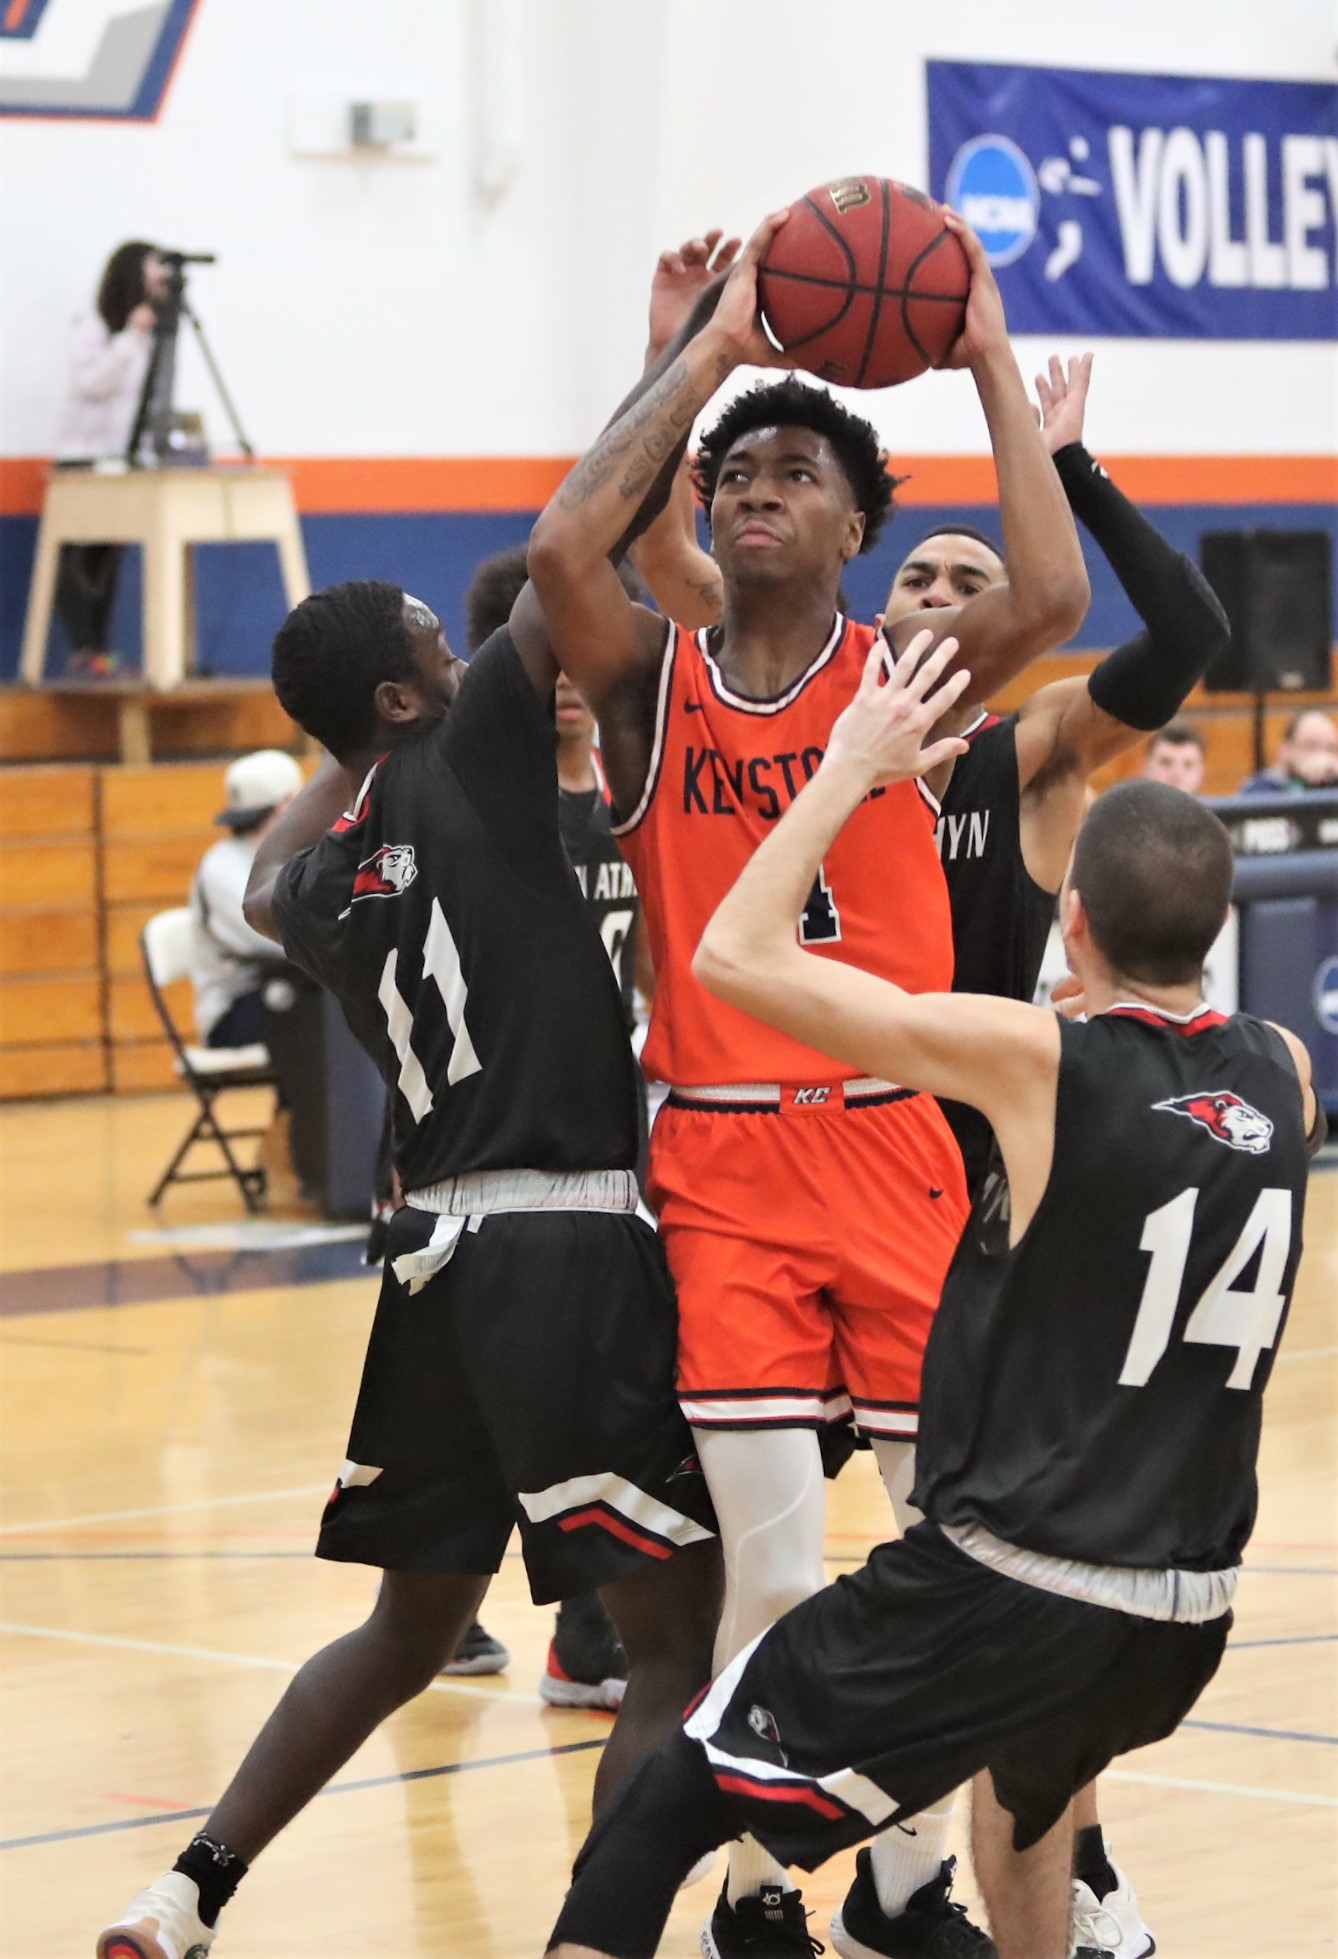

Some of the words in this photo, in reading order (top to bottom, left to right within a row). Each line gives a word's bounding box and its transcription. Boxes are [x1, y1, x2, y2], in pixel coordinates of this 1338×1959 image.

[684, 746, 887, 820] KEYSTO
[378, 896, 483, 1125] 11
[1117, 1187, 1292, 1390] 14
